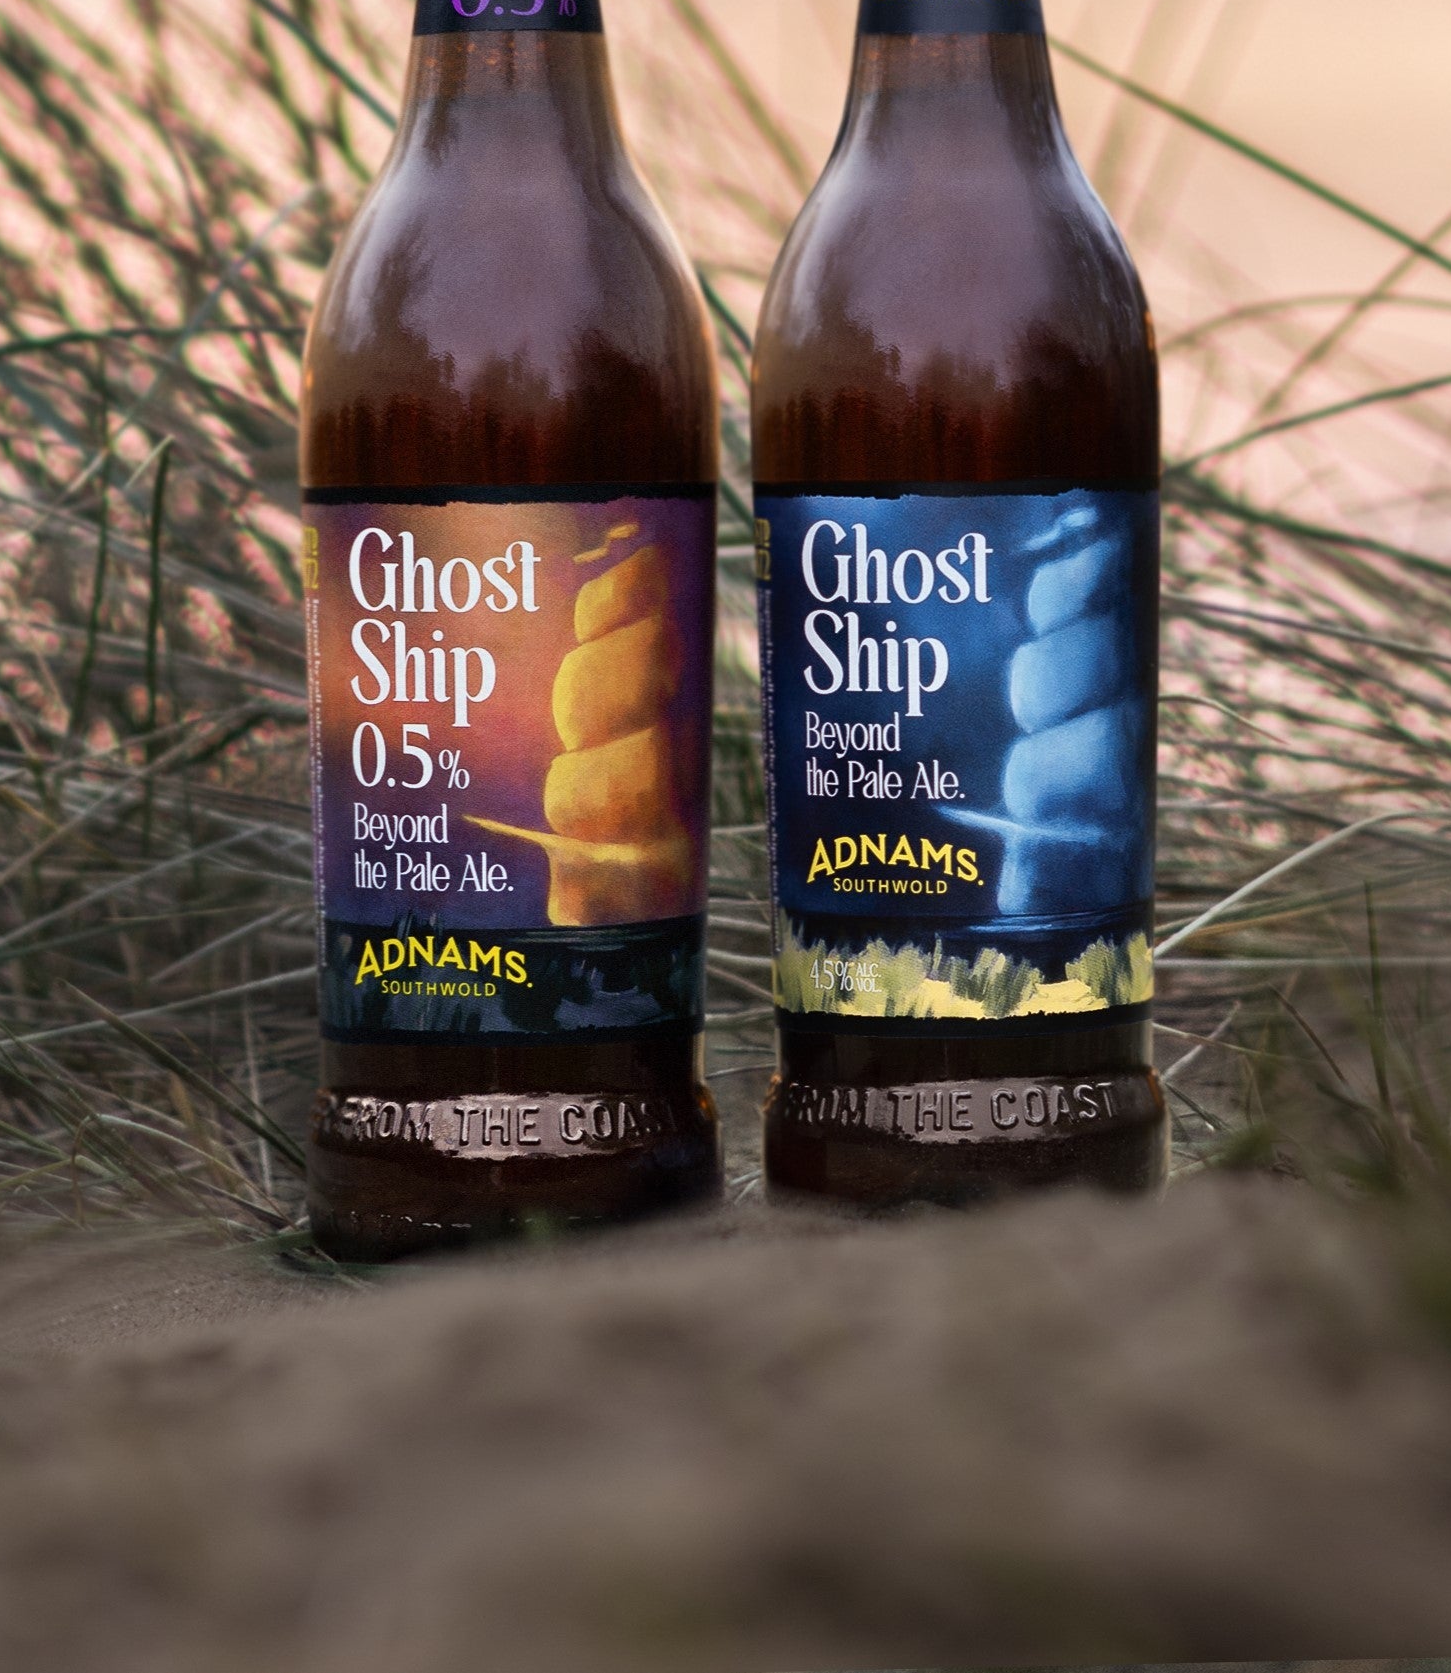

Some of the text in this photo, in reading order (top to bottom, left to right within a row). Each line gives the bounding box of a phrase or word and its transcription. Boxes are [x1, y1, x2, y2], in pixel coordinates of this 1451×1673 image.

[348, 527, 542, 614] Ghost
[801, 519, 995, 605] Ghost
[350, 618, 497, 728] Ship
[802, 608, 950, 717] Ship
[351, 721, 471, 790] 0.5%
[804, 710, 901, 759] Beyond
[805, 757, 966, 800] the Pale Ale.
[353, 802, 450, 851] Beyond
[354, 848, 515, 893] the Pale Ale.
[832, 877, 949, 895] SOUTHWOLD
[380, 980, 498, 998] SOUTHWOLD
[452, 1105, 541, 1147] THE
[560, 1100, 677, 1144] COA
[890, 1088, 975, 1132] THE
[989, 1082, 1119, 1129] COAST
